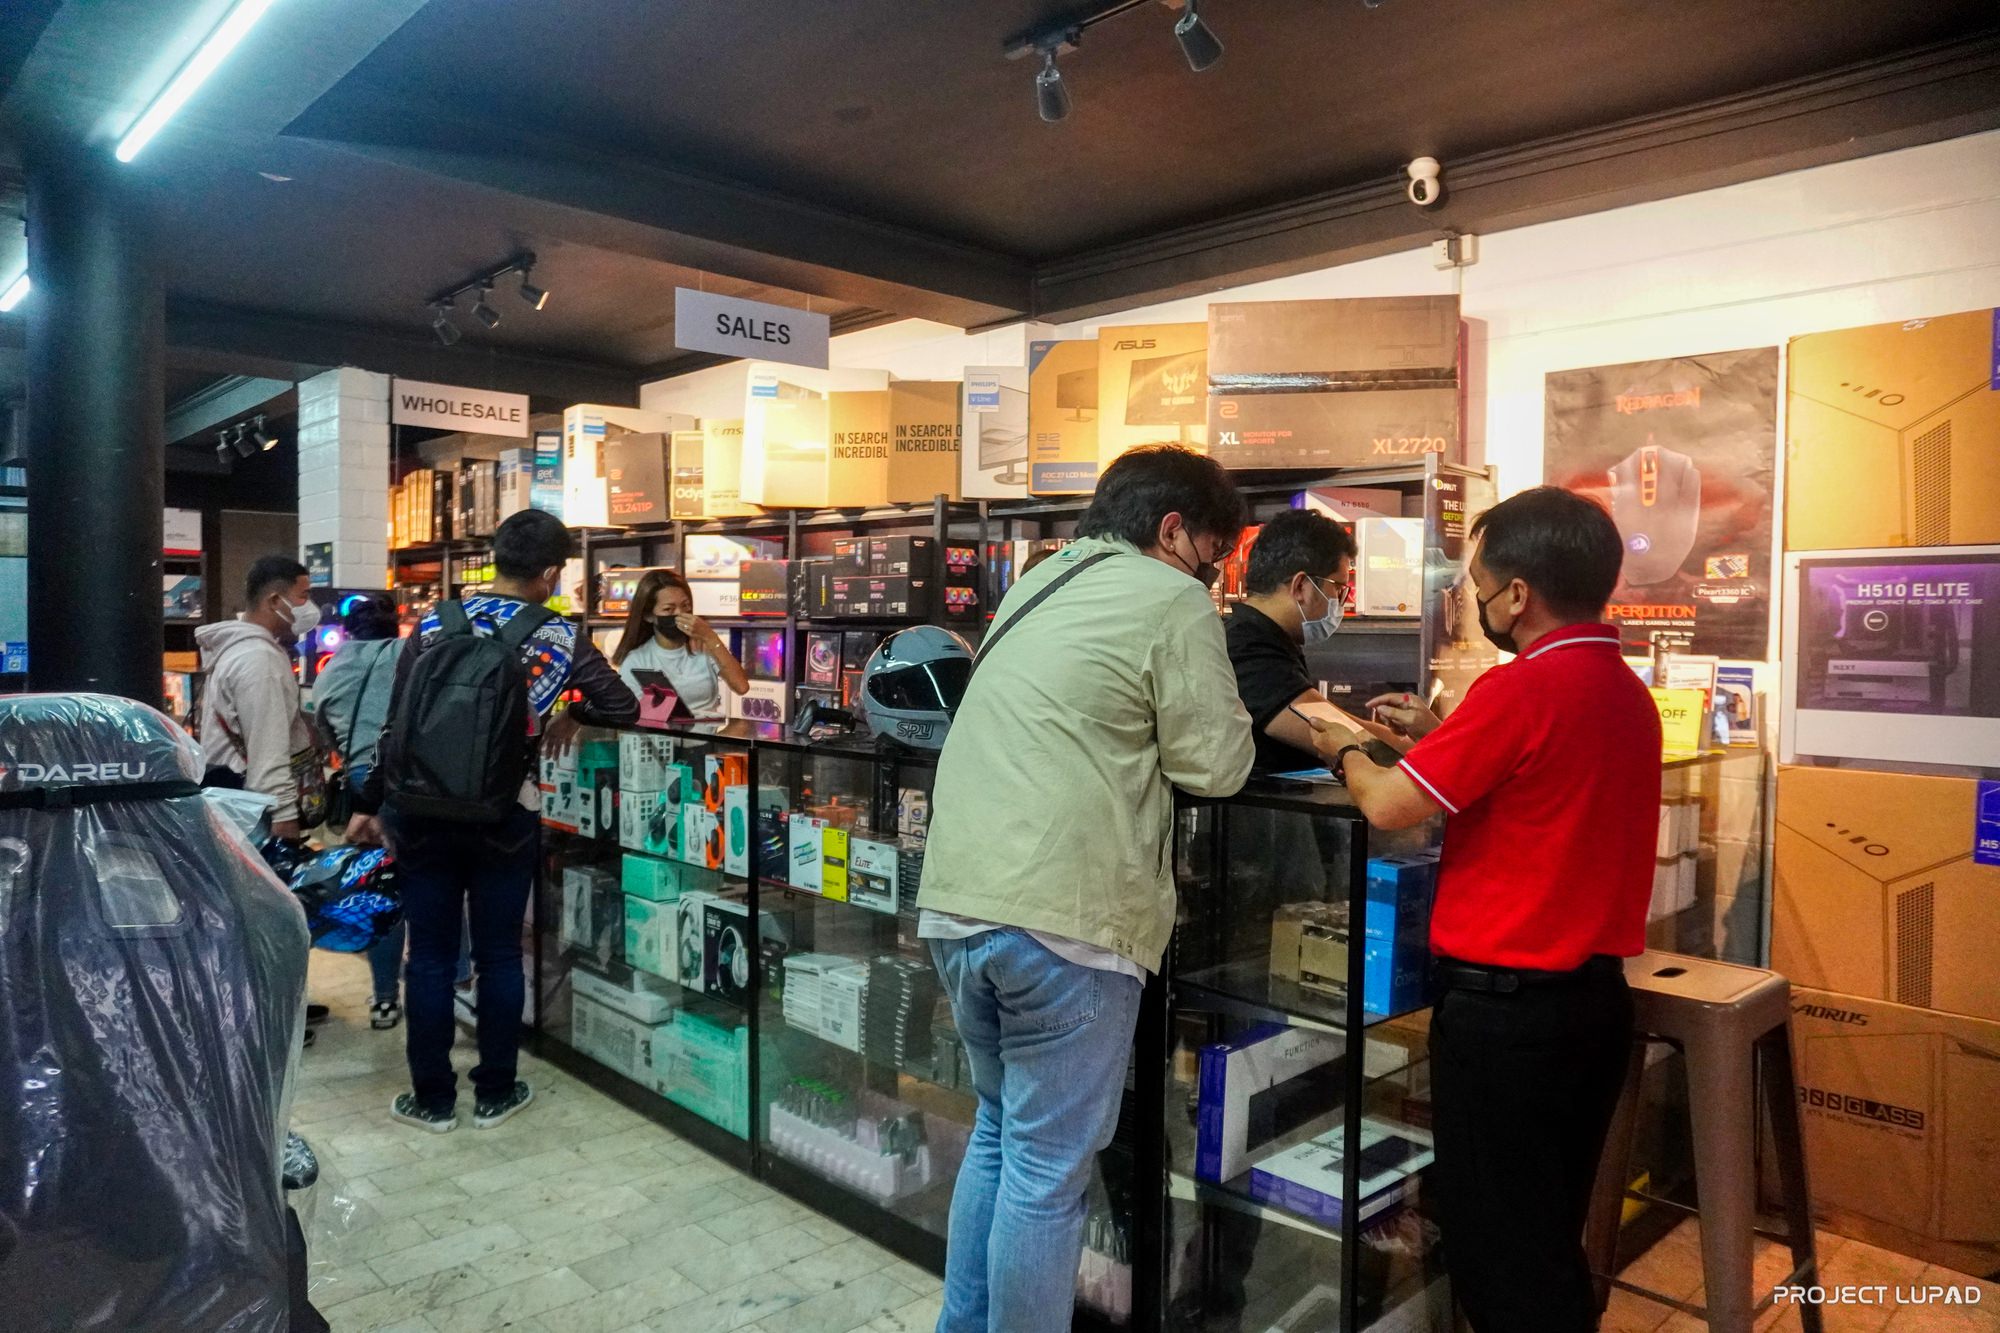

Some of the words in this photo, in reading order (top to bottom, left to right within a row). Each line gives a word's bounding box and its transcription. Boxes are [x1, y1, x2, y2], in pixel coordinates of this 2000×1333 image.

[716, 314, 791, 345] SALES
[1114, 339, 1156, 350] ASUS
[402, 395, 520, 422] WHOLESALE
[896, 425, 907, 437] IN
[910, 424, 952, 437] SEARCH
[834, 433, 845, 444] IN
[848, 432, 888, 444] SEARCH
[896, 439, 959, 451] INCREDIBLE
[1219, 431, 1240, 445] XL
[834, 447, 888, 458] INCREDIBL
[1372, 437, 1447, 455] XL2720
[537, 469, 554, 480] get
[1443, 500, 1458, 511] THE
[1858, 584, 1907, 597] H510
[1912, 582, 1970, 597] ELITE
[1606, 604, 1696, 620] PERDITION
[1661, 709, 1687, 719] OFF
[897, 721, 934, 740] SPY
[17, 762, 146, 782] DAREU
[1793, 1004, 1870, 1026] AORUS
[1846, 1096, 1923, 1129] GLASS
